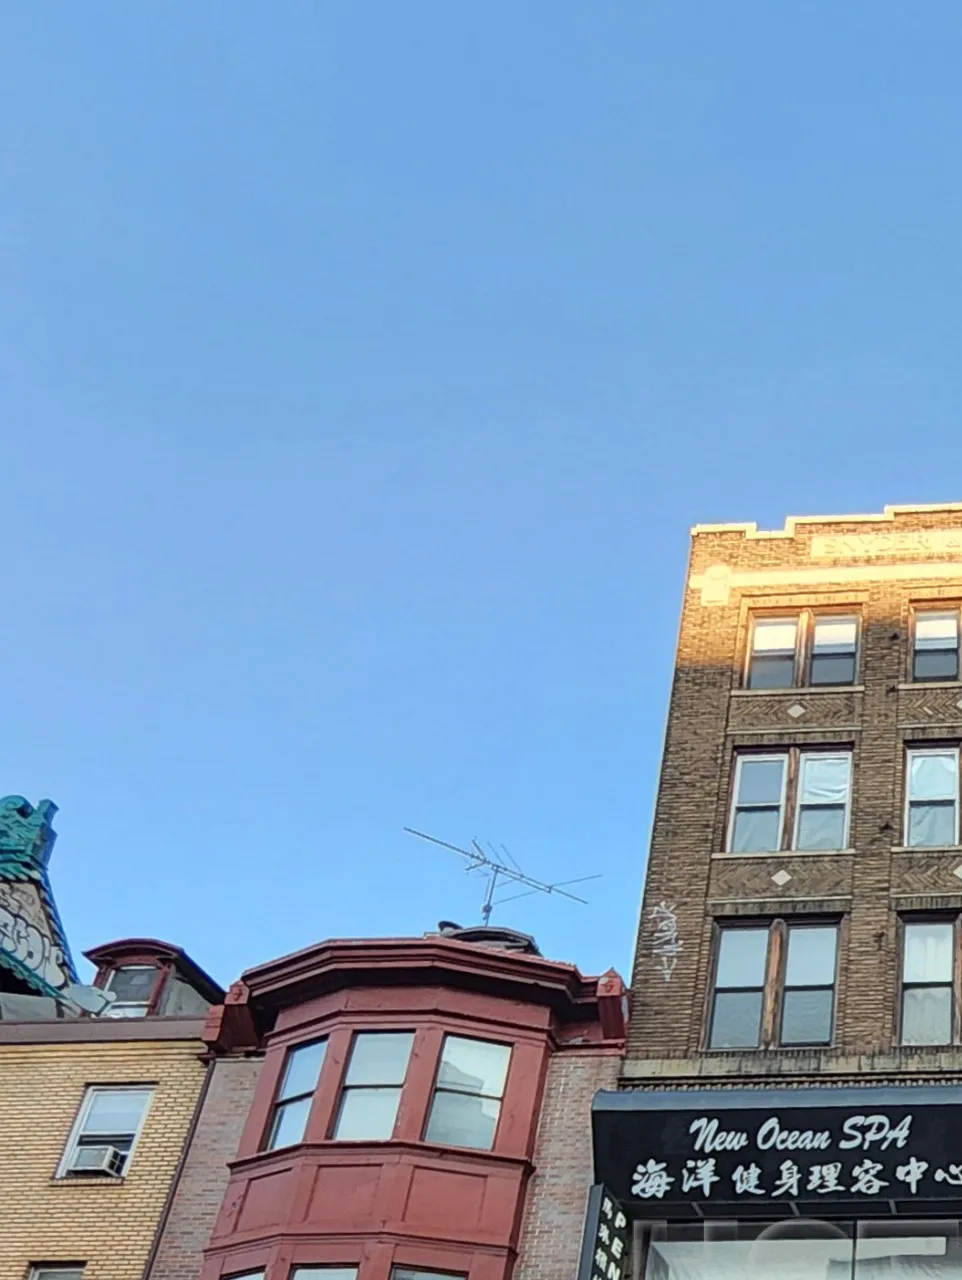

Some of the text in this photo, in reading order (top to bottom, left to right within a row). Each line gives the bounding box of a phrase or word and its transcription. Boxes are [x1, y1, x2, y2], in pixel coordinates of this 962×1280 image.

[688, 1114, 913, 1153] New Ocean SPA
